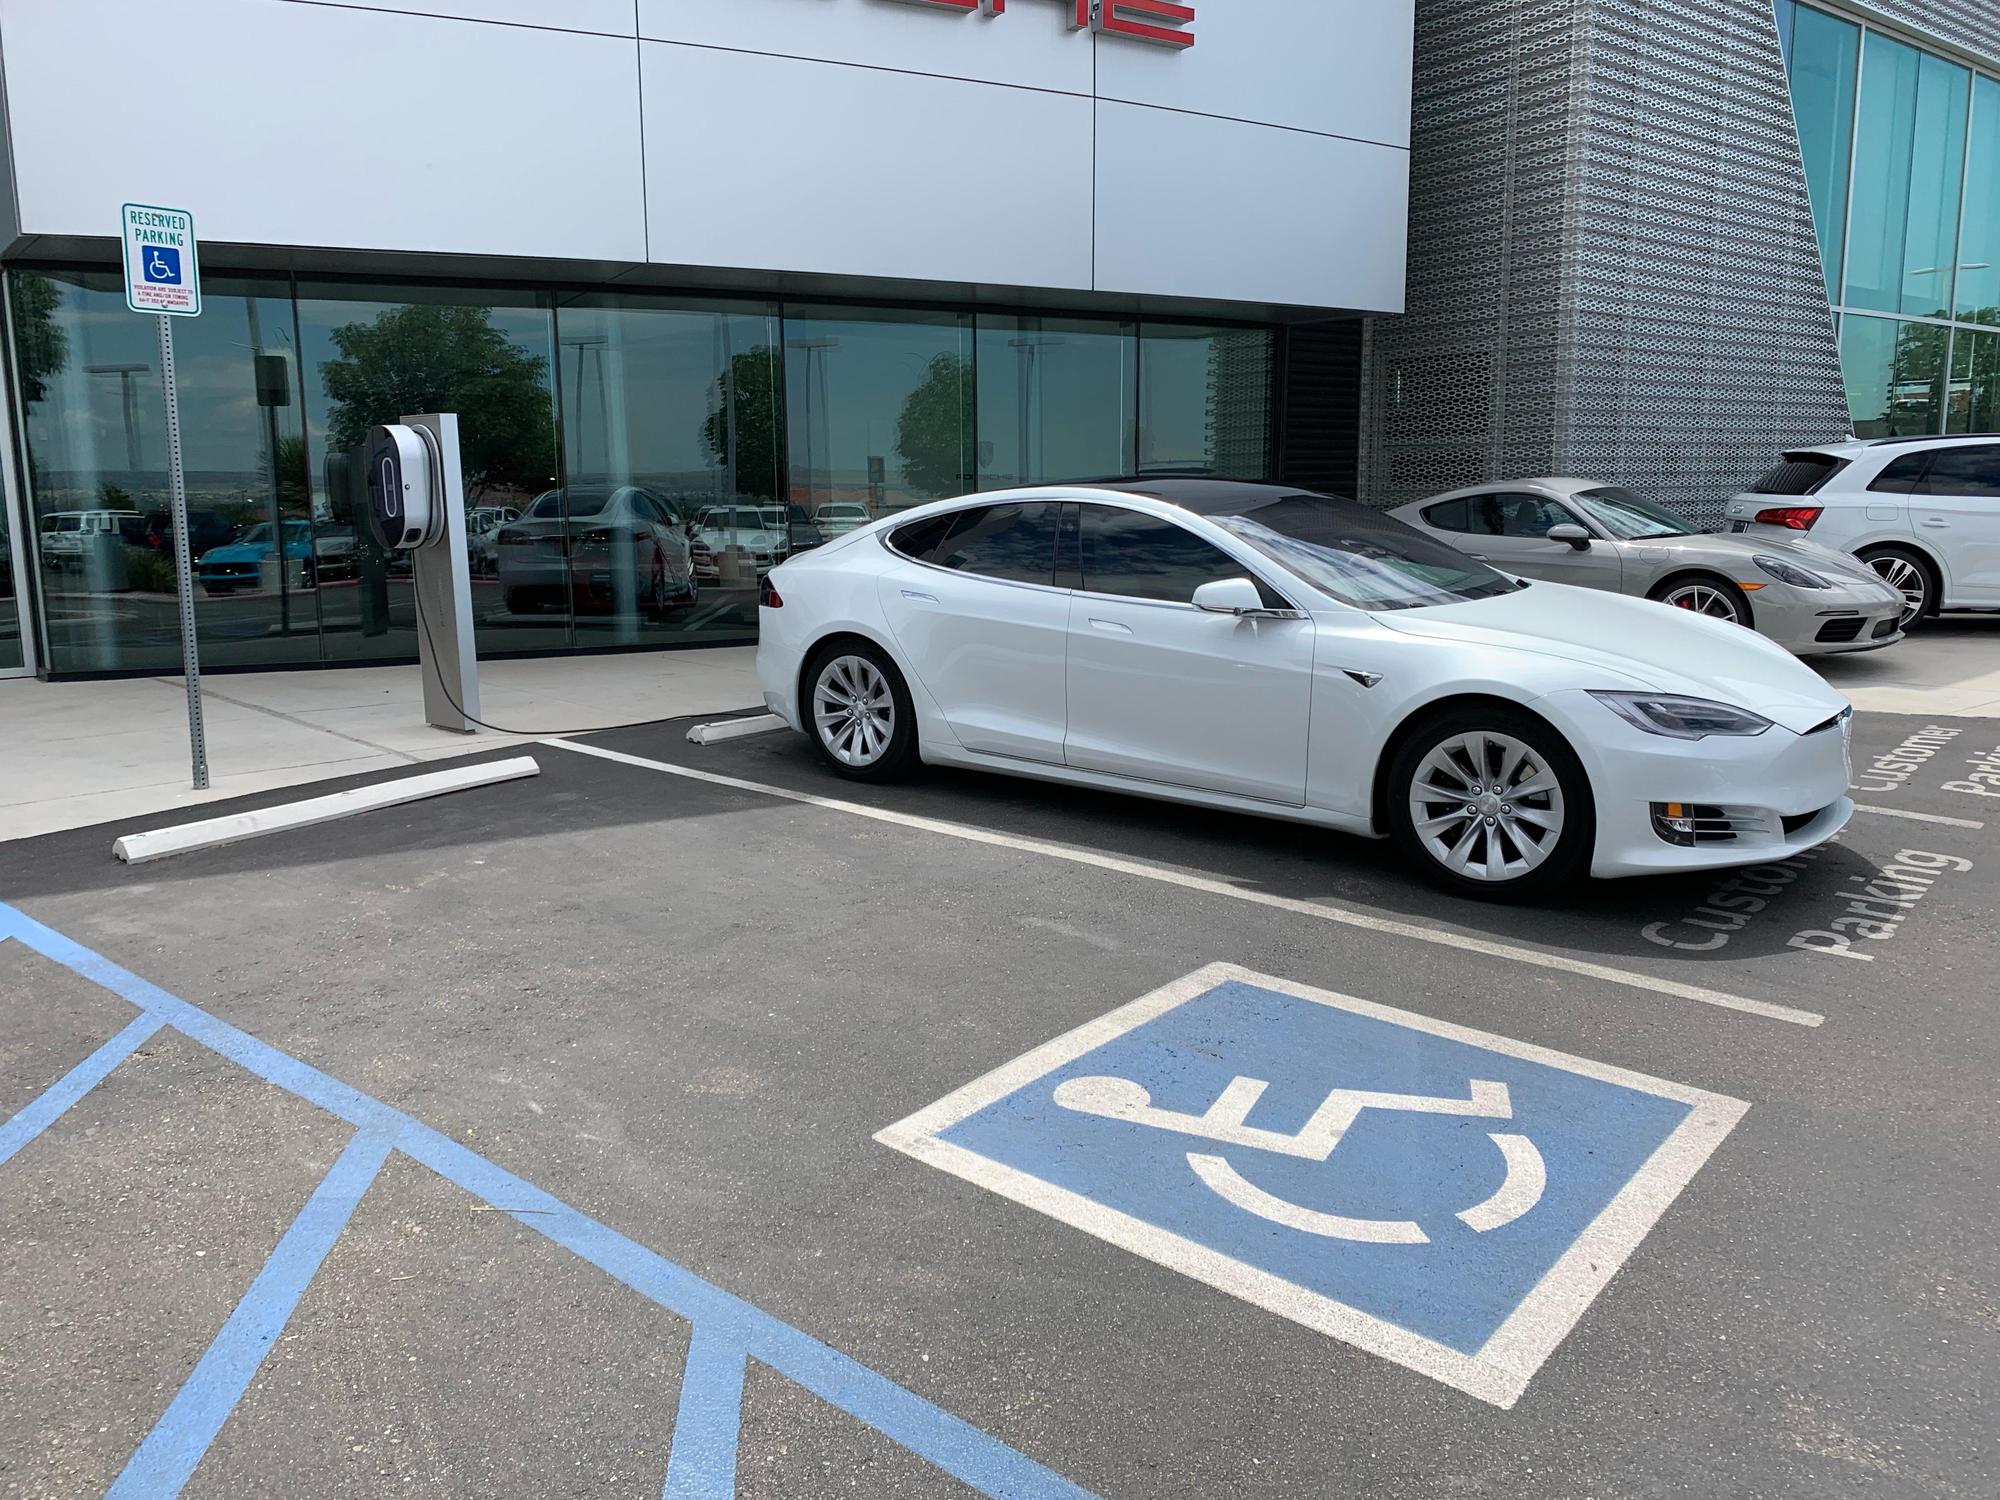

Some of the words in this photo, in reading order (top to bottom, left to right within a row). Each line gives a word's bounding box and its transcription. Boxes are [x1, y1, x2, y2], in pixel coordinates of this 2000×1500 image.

[130, 210, 185, 230] RESERVED
[135, 228, 184, 246] PARKING
[1940, 745, 2000, 797] Park
[1641, 829, 1848, 951] Custo
[1786, 849, 1974, 961] Parking
